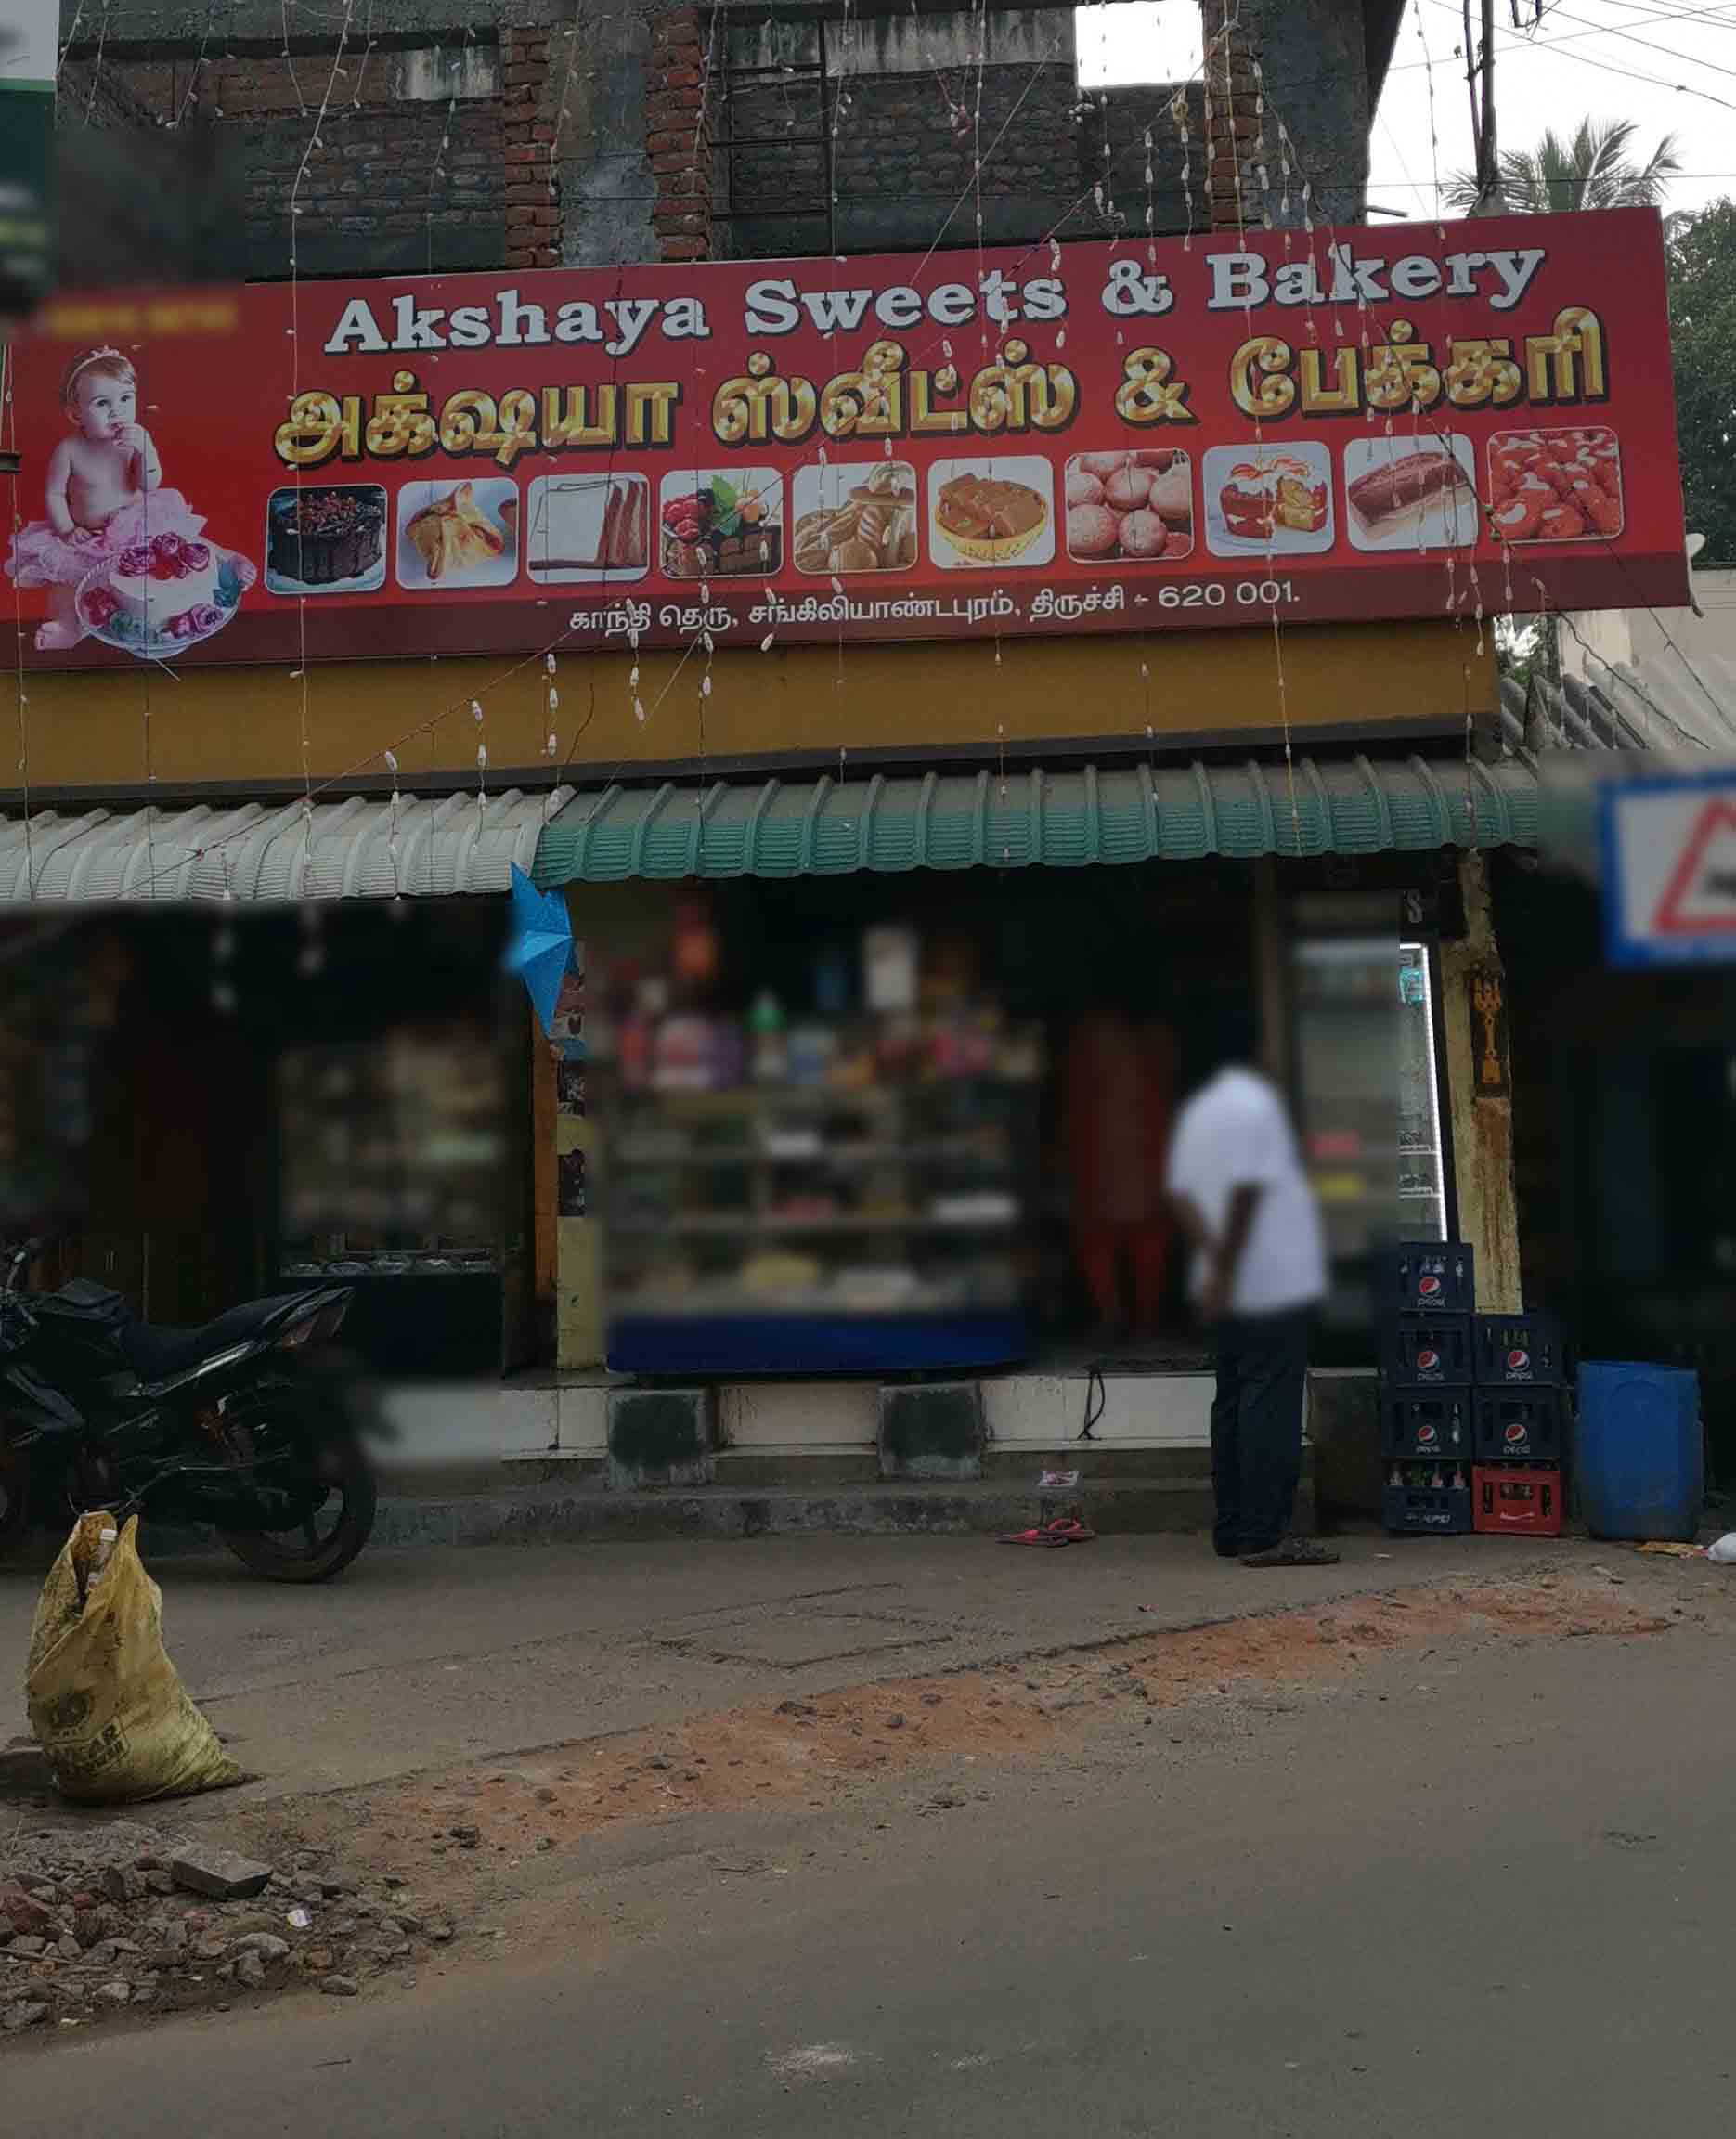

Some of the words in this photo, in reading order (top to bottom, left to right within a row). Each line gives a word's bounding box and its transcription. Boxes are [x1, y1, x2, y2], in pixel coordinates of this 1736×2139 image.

[324, 290, 712, 357] Akshaya
[744, 269, 1068, 340] Sweets
[1101, 257, 1172, 314] &
[1205, 243, 1545, 312] Bakery
[272, 371, 680, 467] அக்ஷயா
[712, 338, 1080, 443] ஸ்வீட்ஸ்
[1114, 346, 1193, 424] &
[1229, 306, 1608, 418] பேக்கரி
[568, 601, 653, 639] காந்தி
[660, 603, 740, 635] தெரு,
[1030, 584, 1125, 624] திருச்சி
[1158, 583, 1225, 609] 620
[1236, 580, 1301, 606] 001.
